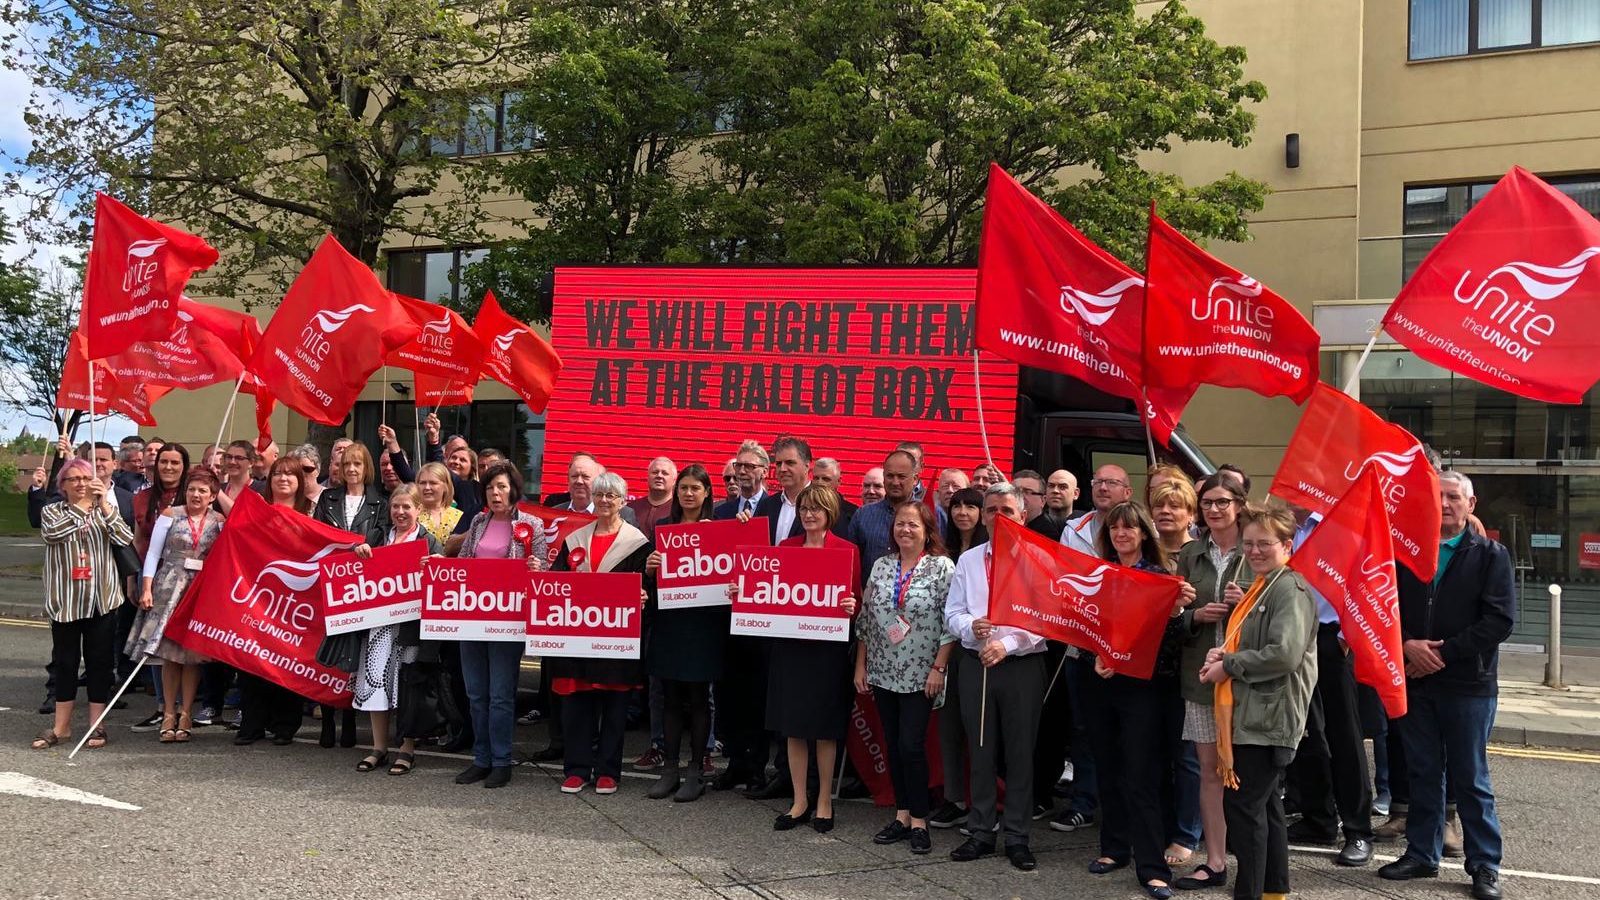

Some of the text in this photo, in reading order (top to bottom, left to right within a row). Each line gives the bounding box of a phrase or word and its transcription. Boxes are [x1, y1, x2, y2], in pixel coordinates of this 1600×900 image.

[585, 299, 977, 357] WE WILL FIGHT THEM
[1462, 316, 1534, 363] theUNION
[1159, 343, 1302, 379] www.unitetheunion.org
[589, 359, 634, 407] AT
[644, 359, 712, 410] THE
[720, 362, 865, 417] BALLOT
[872, 366, 964, 422] BOX.
[660, 531, 700, 549] Vote
[323, 560, 364, 579] Vote
[660, 548, 736, 579] Labo
[740, 553, 781, 572] Vote
[428, 564, 468, 582] Vote
[325, 570, 422, 607] Labour
[531, 578, 572, 597] Vote
[670, 592, 698, 601] Labour
[737, 574, 847, 608] Labour
[426, 583, 526, 612] Labour
[338, 616, 364, 627] Labour
[530, 598, 636, 629] Labour
[241, 612, 304, 648] theUNION
[432, 624, 460, 633] Labour
[743, 618, 771, 629] Labour
[798, 622, 844, 634] labour.org.uk
[537, 640, 566, 649] Labour
[591, 643, 635, 652] labour.org.uk
